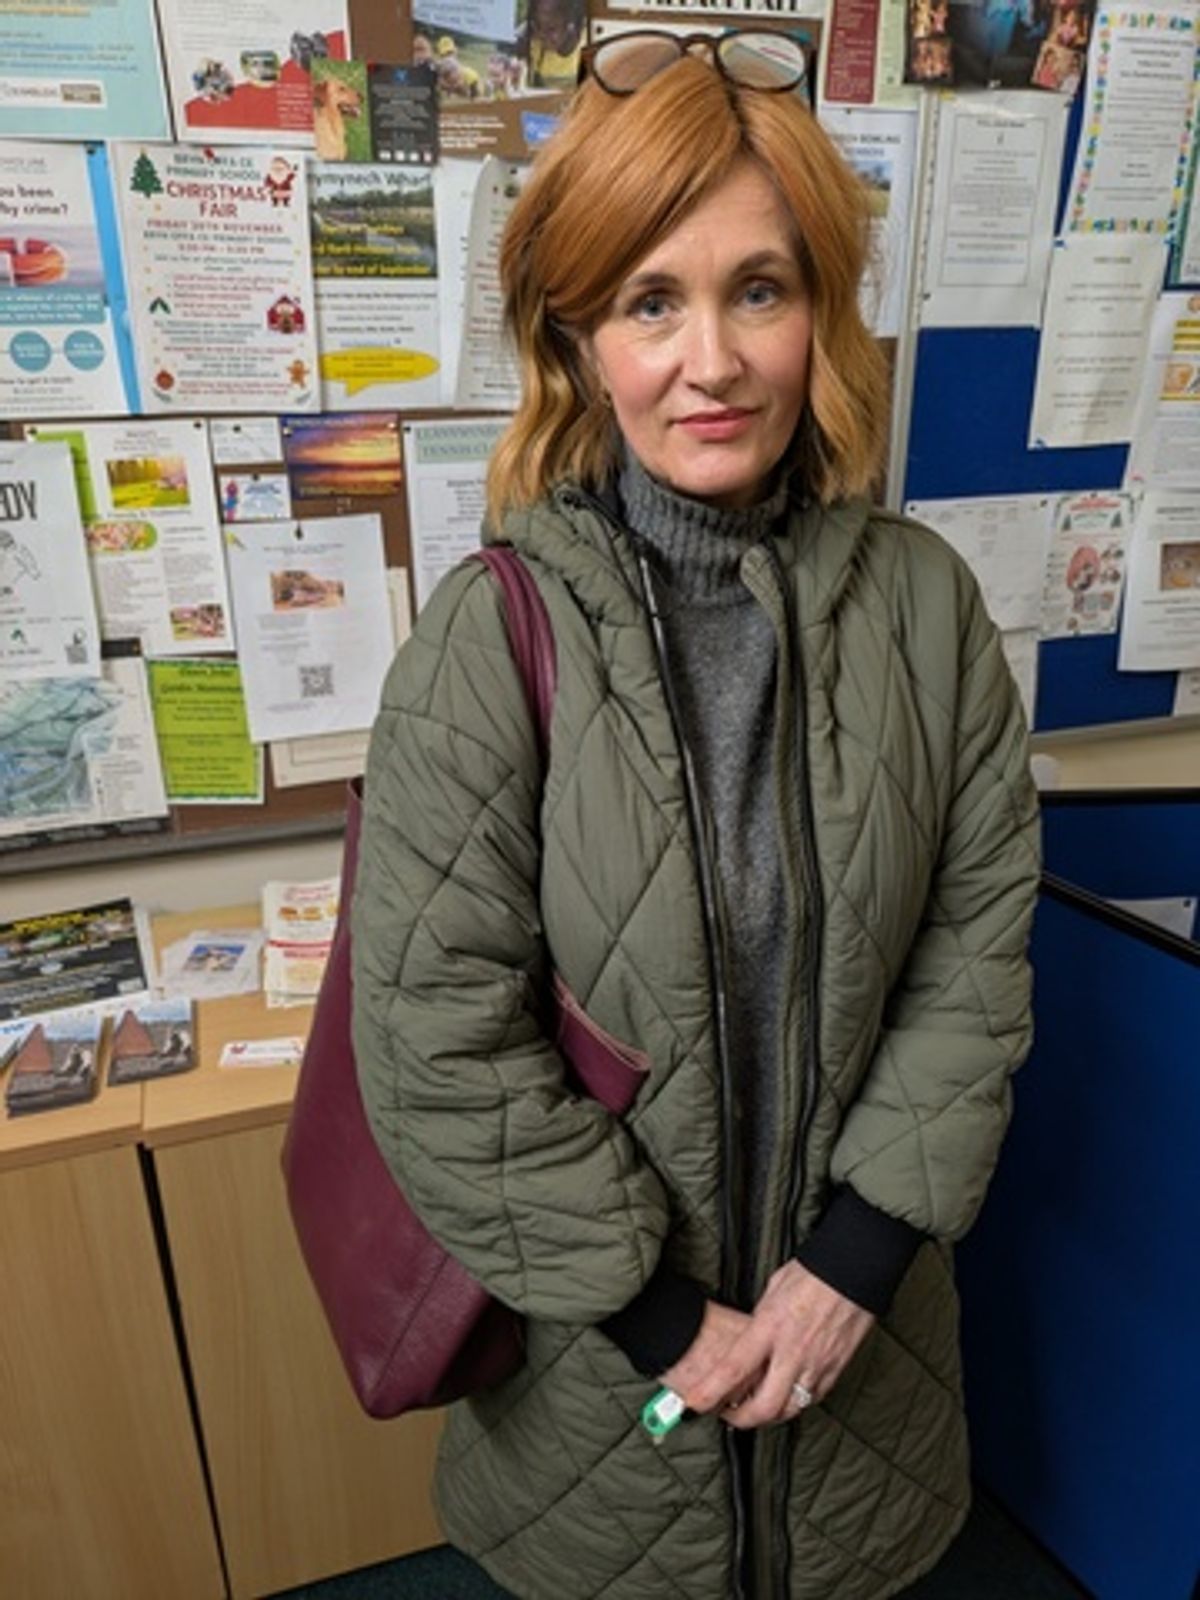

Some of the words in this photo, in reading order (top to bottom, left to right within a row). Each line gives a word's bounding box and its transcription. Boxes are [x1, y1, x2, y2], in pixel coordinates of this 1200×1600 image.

[219, 169, 261, 181] SCHOOL
[17, 184, 54, 198] been
[166, 180, 267, 201] CHRISTMAS
[23, 202, 68, 215] crime?
[199, 201, 238, 218] FAIR
[223, 223, 283, 233] NOVEMBER
